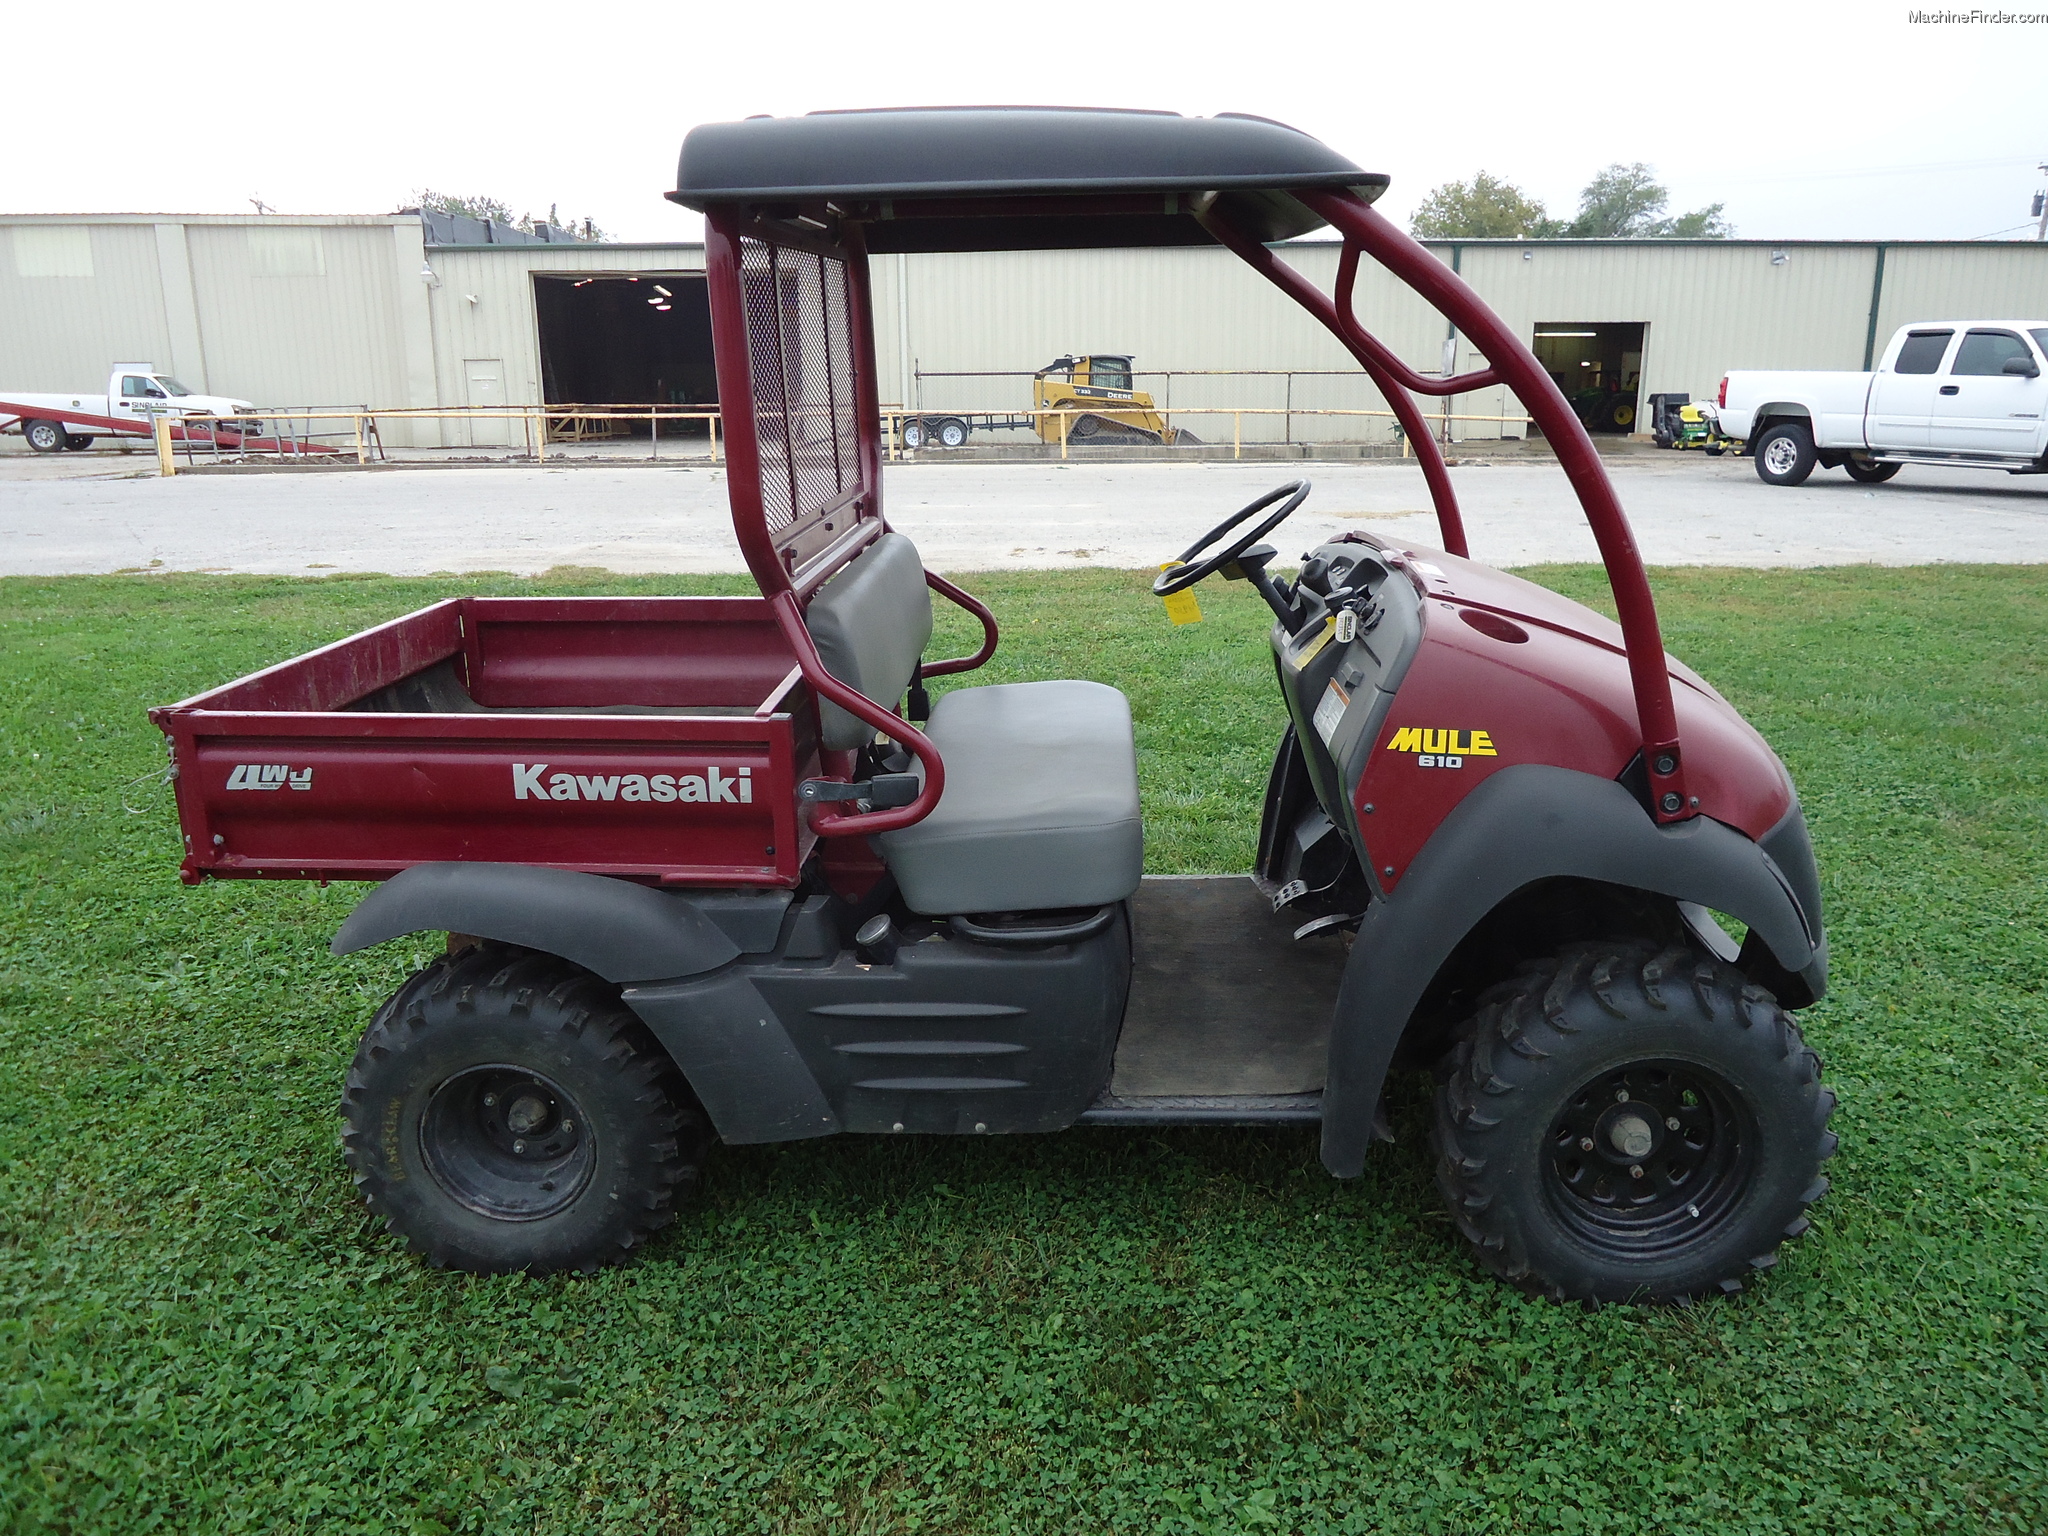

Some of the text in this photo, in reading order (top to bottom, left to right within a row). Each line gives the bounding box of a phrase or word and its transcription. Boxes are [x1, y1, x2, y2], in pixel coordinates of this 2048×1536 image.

[1386, 727, 1498, 756] MULE
[1418, 755, 1463, 769] 610
[512, 763, 753, 803] Kawasaki
